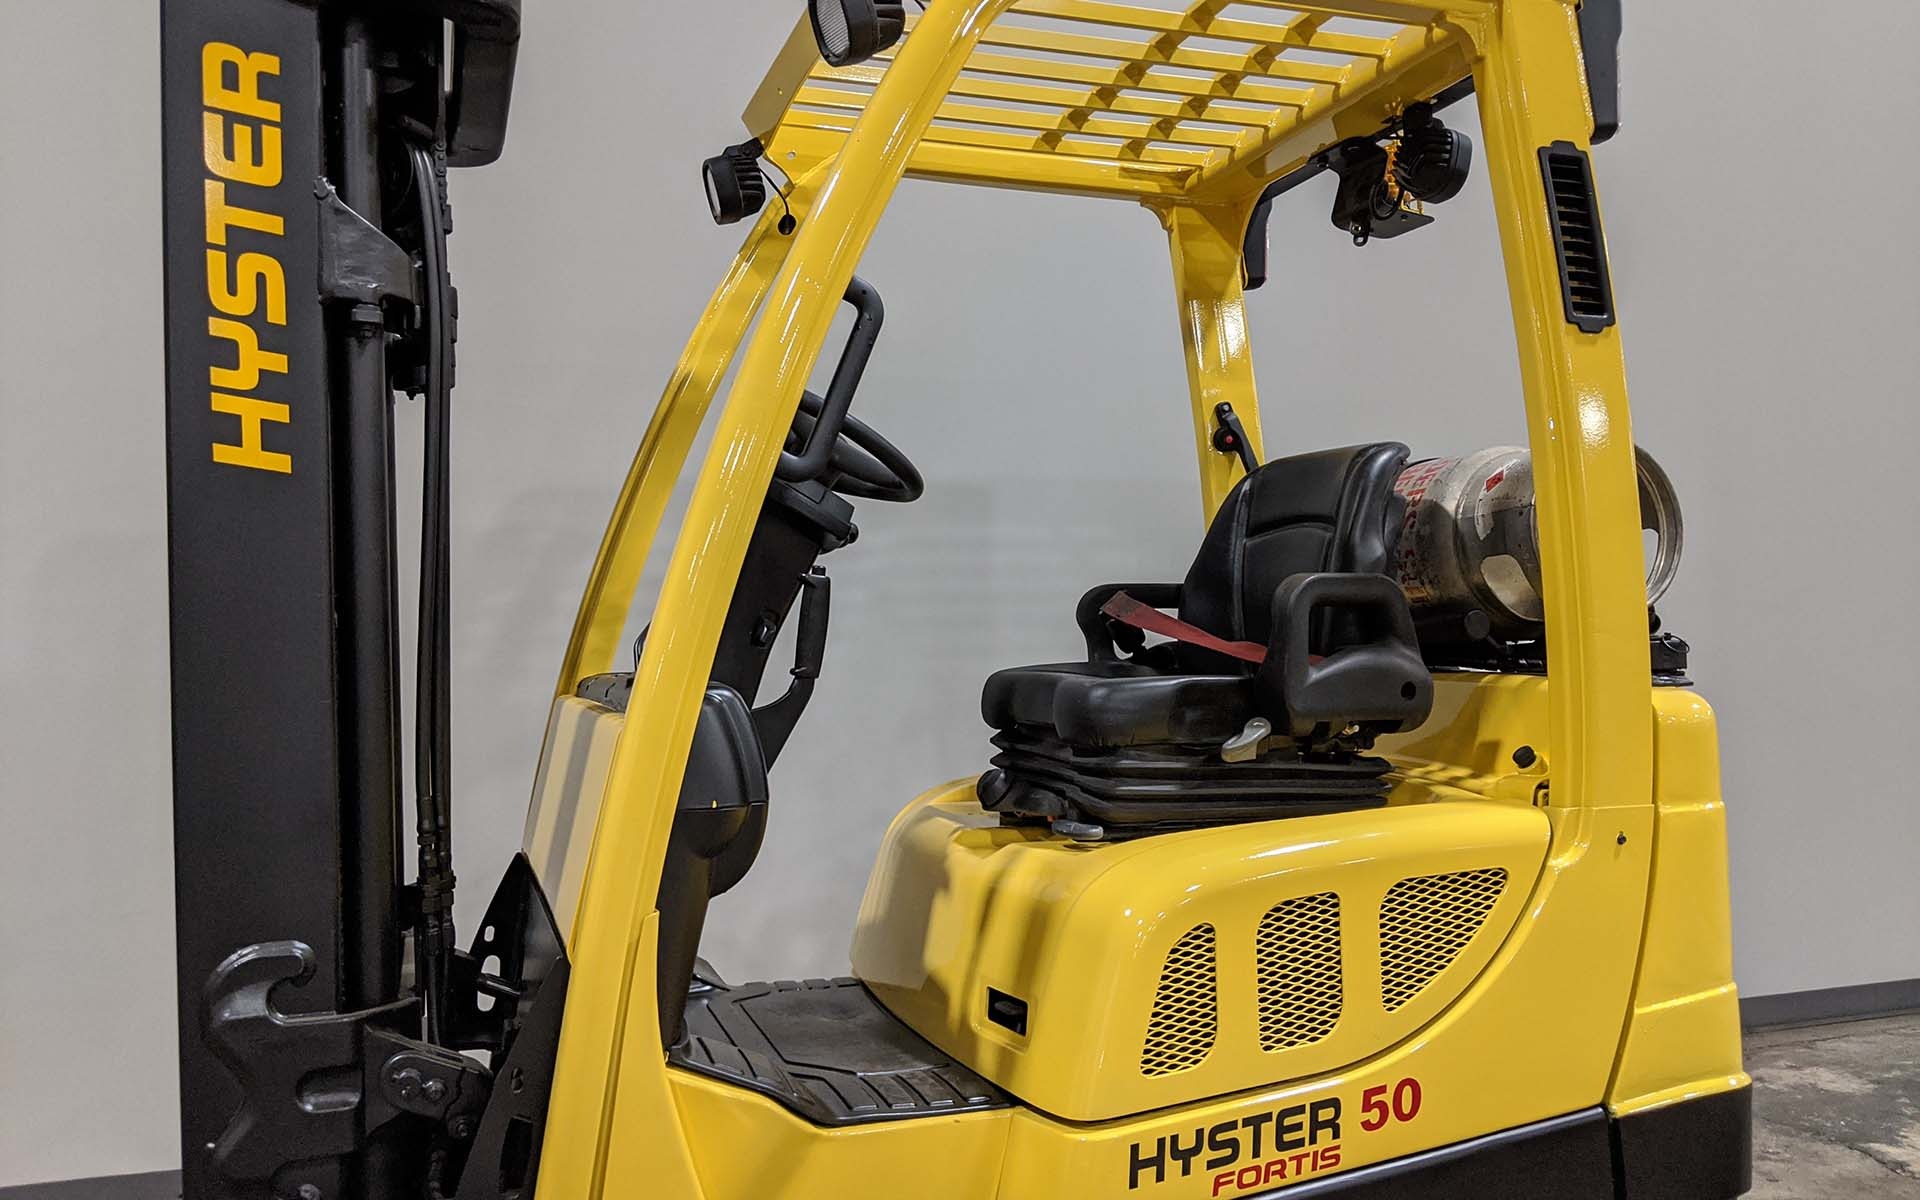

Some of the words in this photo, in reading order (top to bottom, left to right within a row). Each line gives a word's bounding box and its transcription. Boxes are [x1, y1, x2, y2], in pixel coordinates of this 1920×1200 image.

[202, 41, 292, 474] HYSTER
[1129, 1097, 1342, 1190] HYSTER
[1360, 1077, 1422, 1131] 50
[1212, 1144, 1342, 1197] FORTIS
